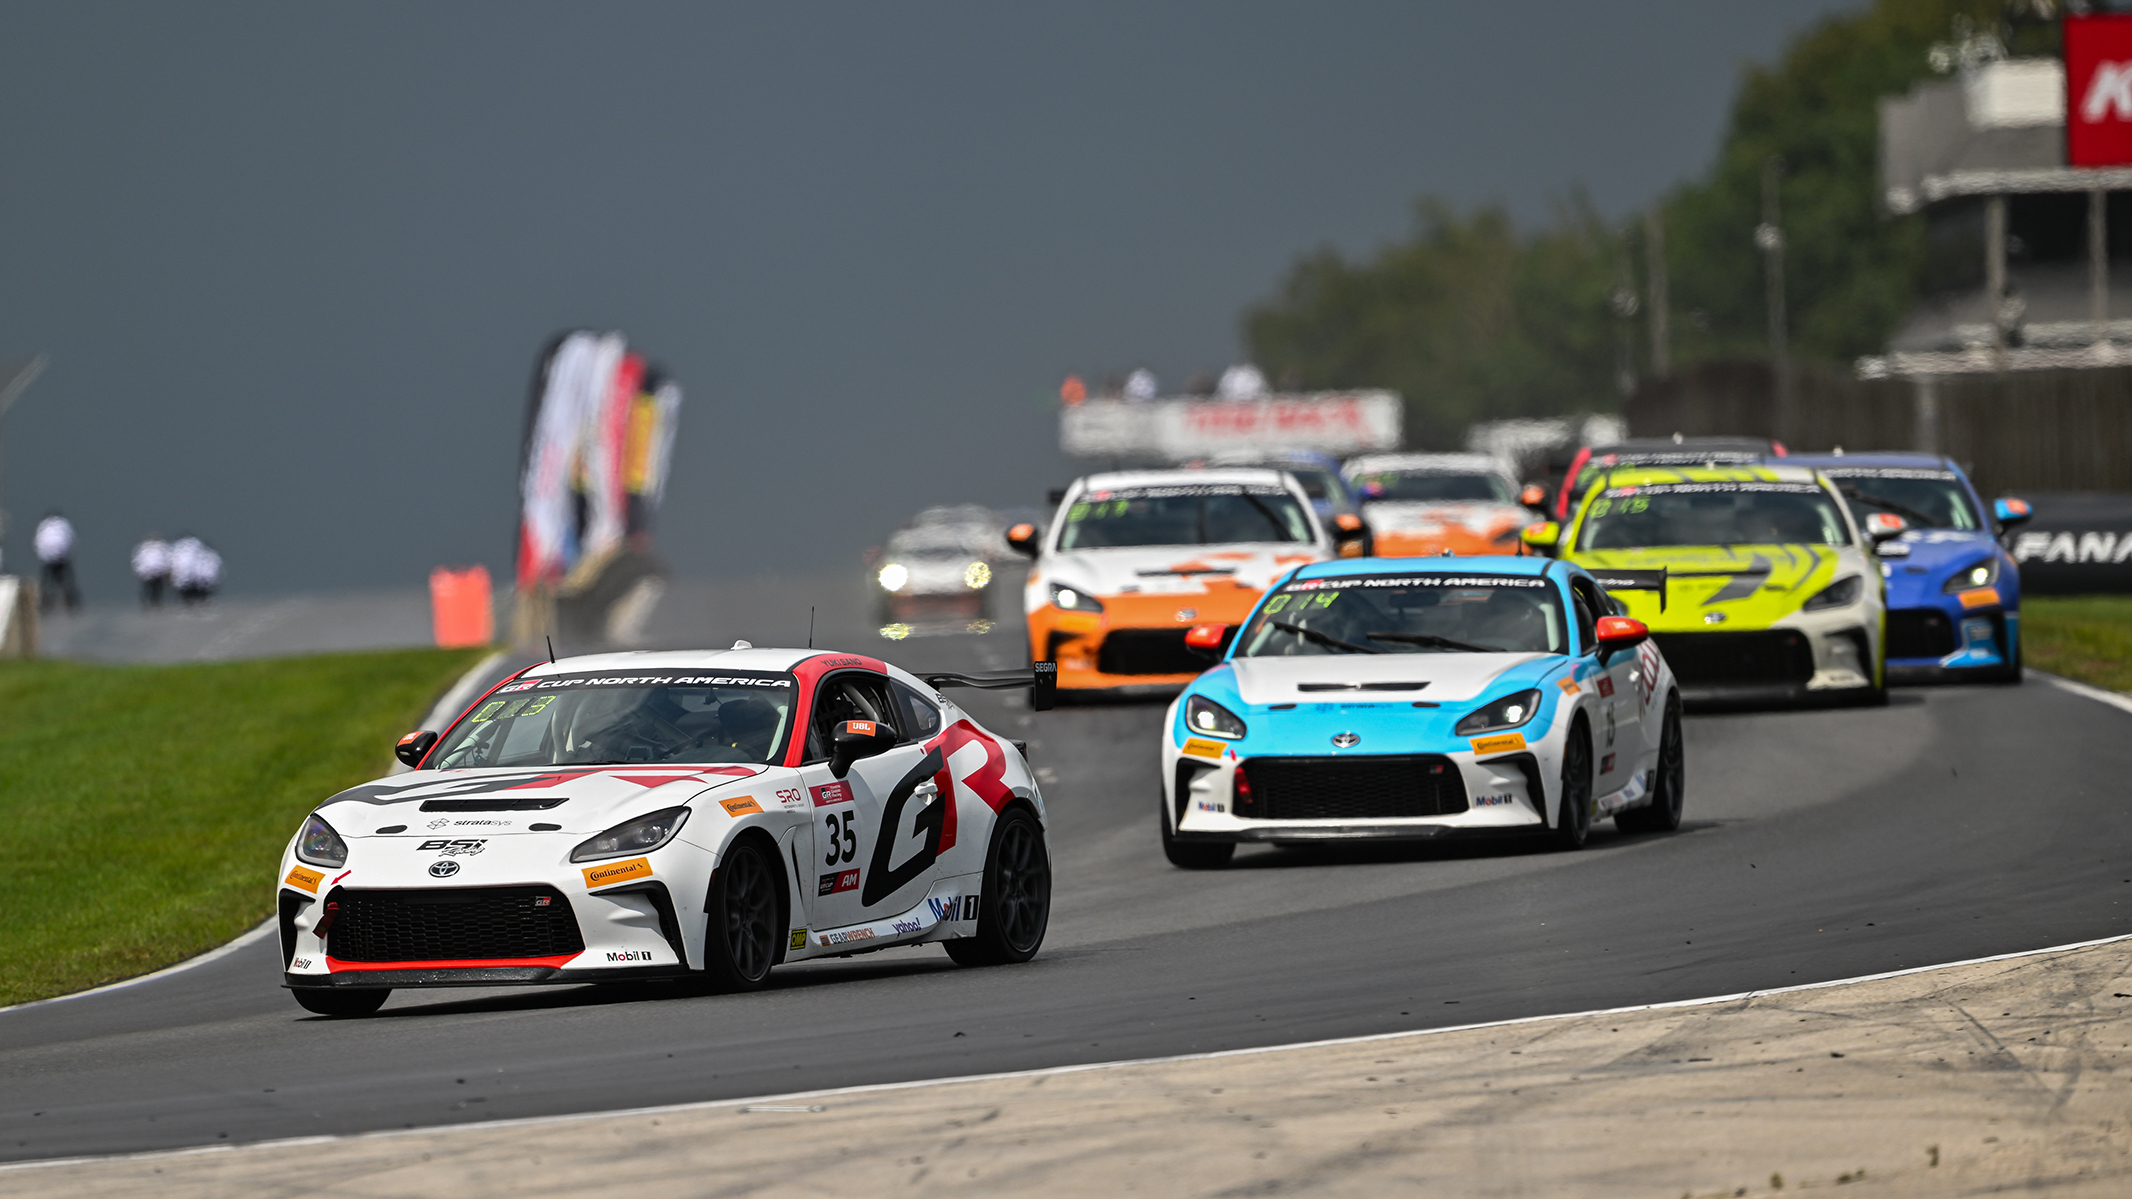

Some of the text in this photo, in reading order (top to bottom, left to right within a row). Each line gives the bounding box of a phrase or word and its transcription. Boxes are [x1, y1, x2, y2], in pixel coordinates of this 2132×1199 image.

[1319, 579, 1362, 590] CUP
[1363, 577, 1442, 588] NORTH
[1443, 577, 1546, 588] AMERICA
[537, 678, 584, 689] CUP
[584, 675, 671, 687] NORTH
[672, 675, 792, 688] AMERICA
[1477, 739, 1514, 750] Continental
[1475, 796, 1503, 806] Mobil
[825, 810, 857, 866] 35
[589, 864, 637, 882] Continental
[842, 873, 858, 888] AM
[891, 917, 922, 939] yahoo!
[791, 933, 806, 946] OMP
[829, 928, 876, 944] GEARWRENCH
[606, 951, 652, 962] Mobil 1
